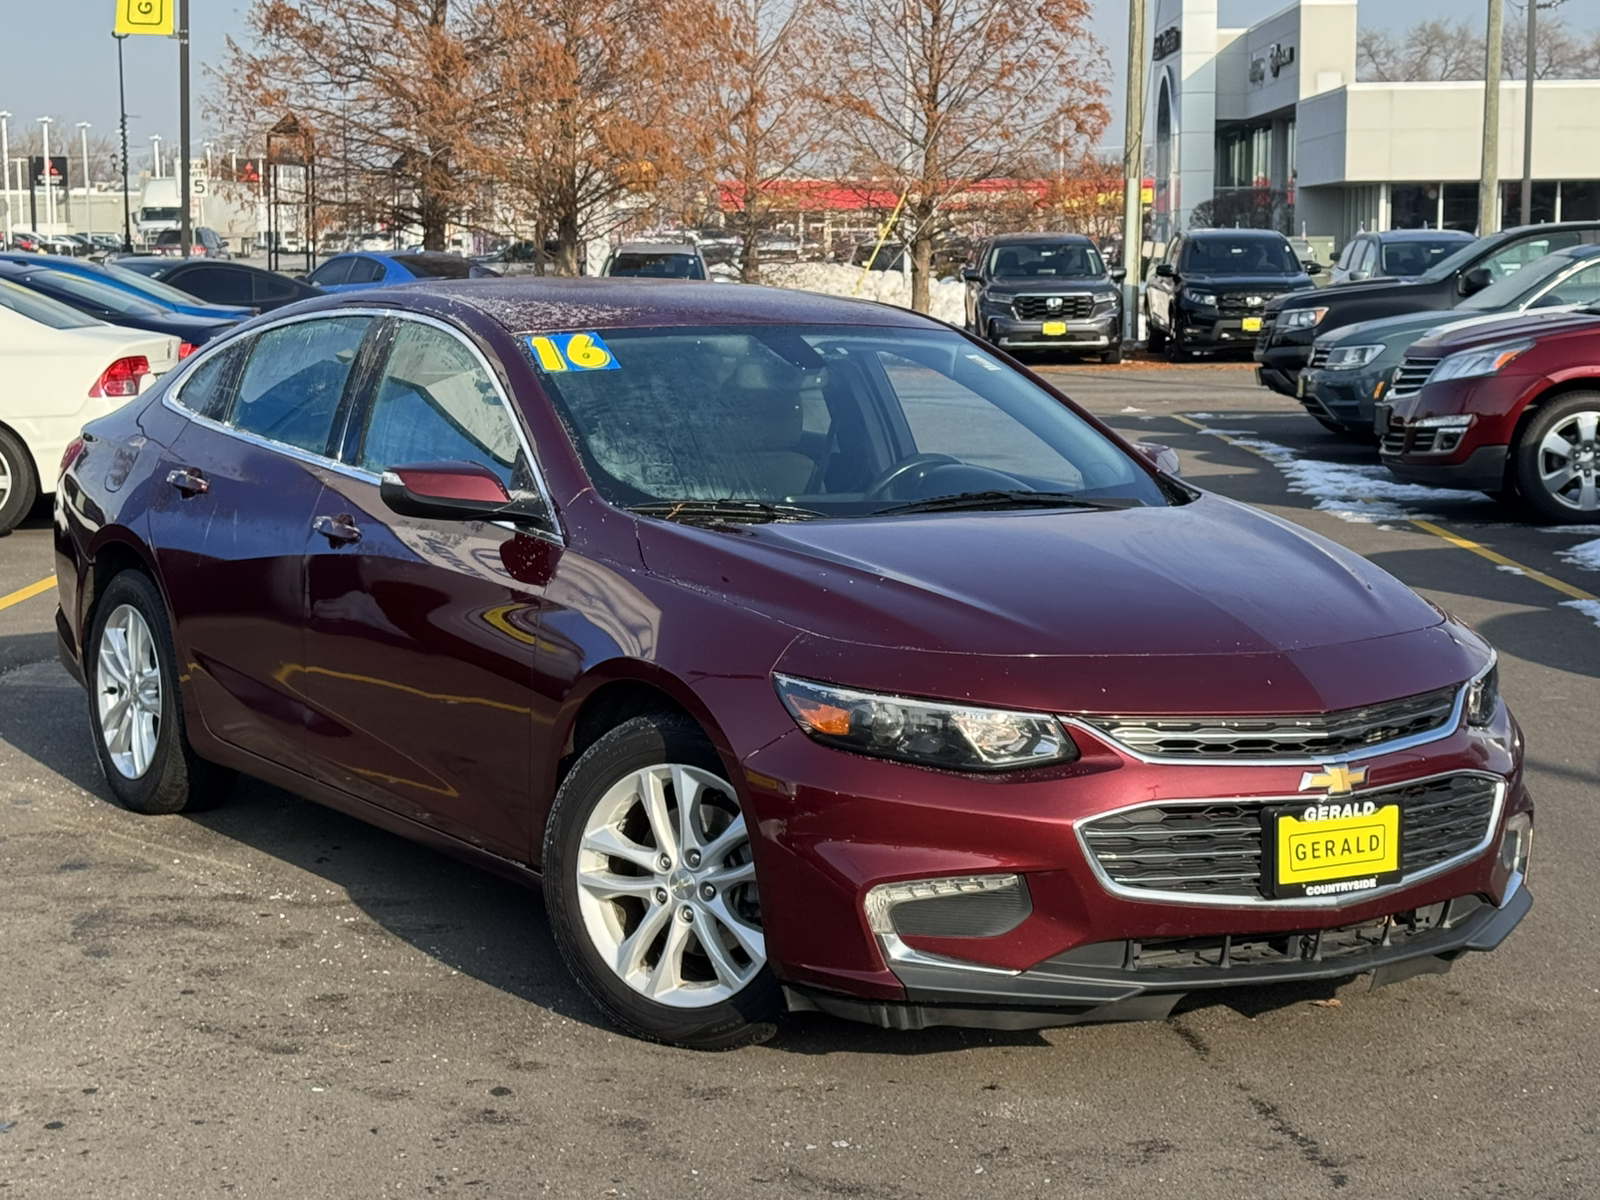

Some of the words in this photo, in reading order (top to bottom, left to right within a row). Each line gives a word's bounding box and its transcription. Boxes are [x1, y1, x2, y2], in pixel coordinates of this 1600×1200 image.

[137, 2, 153, 15] G
[531, 334, 611, 371] 16
[1304, 802, 1376, 822] GERALD
[1295, 834, 1380, 862] GERALD
[1305, 878, 1377, 896] COUNTRYSIDE
